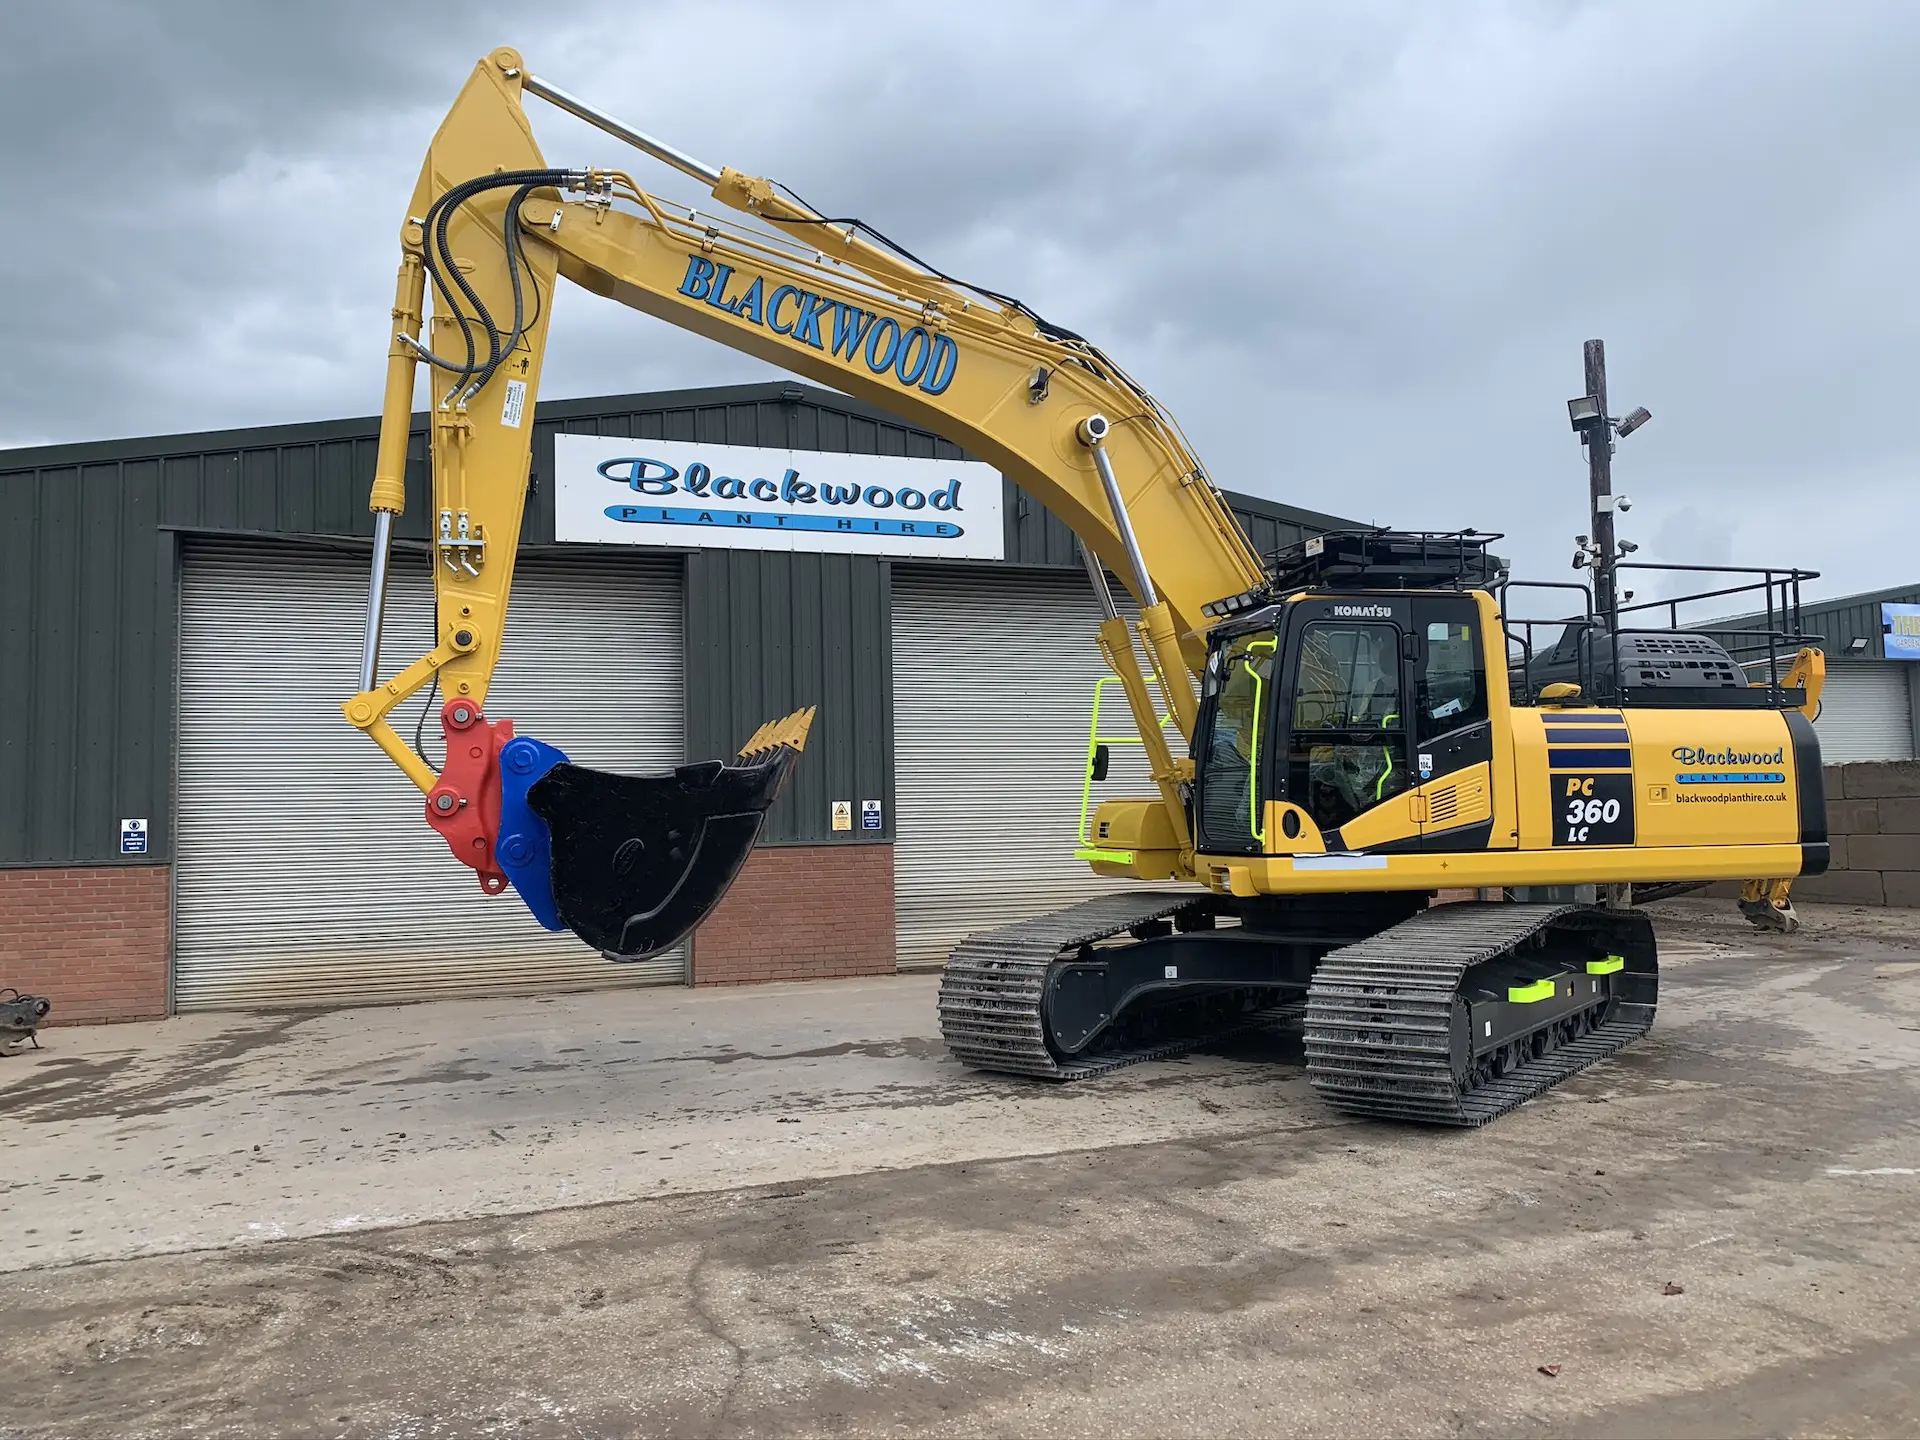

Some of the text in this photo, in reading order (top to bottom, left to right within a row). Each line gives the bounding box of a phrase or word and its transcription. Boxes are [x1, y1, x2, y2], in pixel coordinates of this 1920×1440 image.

[677, 253, 959, 396] BLACKWOOD
[597, 457, 964, 511] Blackwood
[622, 508, 948, 534] PLANT HIRE
[1334, 604, 1392, 617] KOMATSU
[1671, 746, 1785, 765] Blackwood
[1566, 778, 1595, 797] PC
[1678, 774, 1729, 782] PLANT
[1676, 792, 1787, 804] blackwoodplanthire.co.uk
[1566, 799, 1620, 824] 360
[1567, 826, 1589, 842] LC
